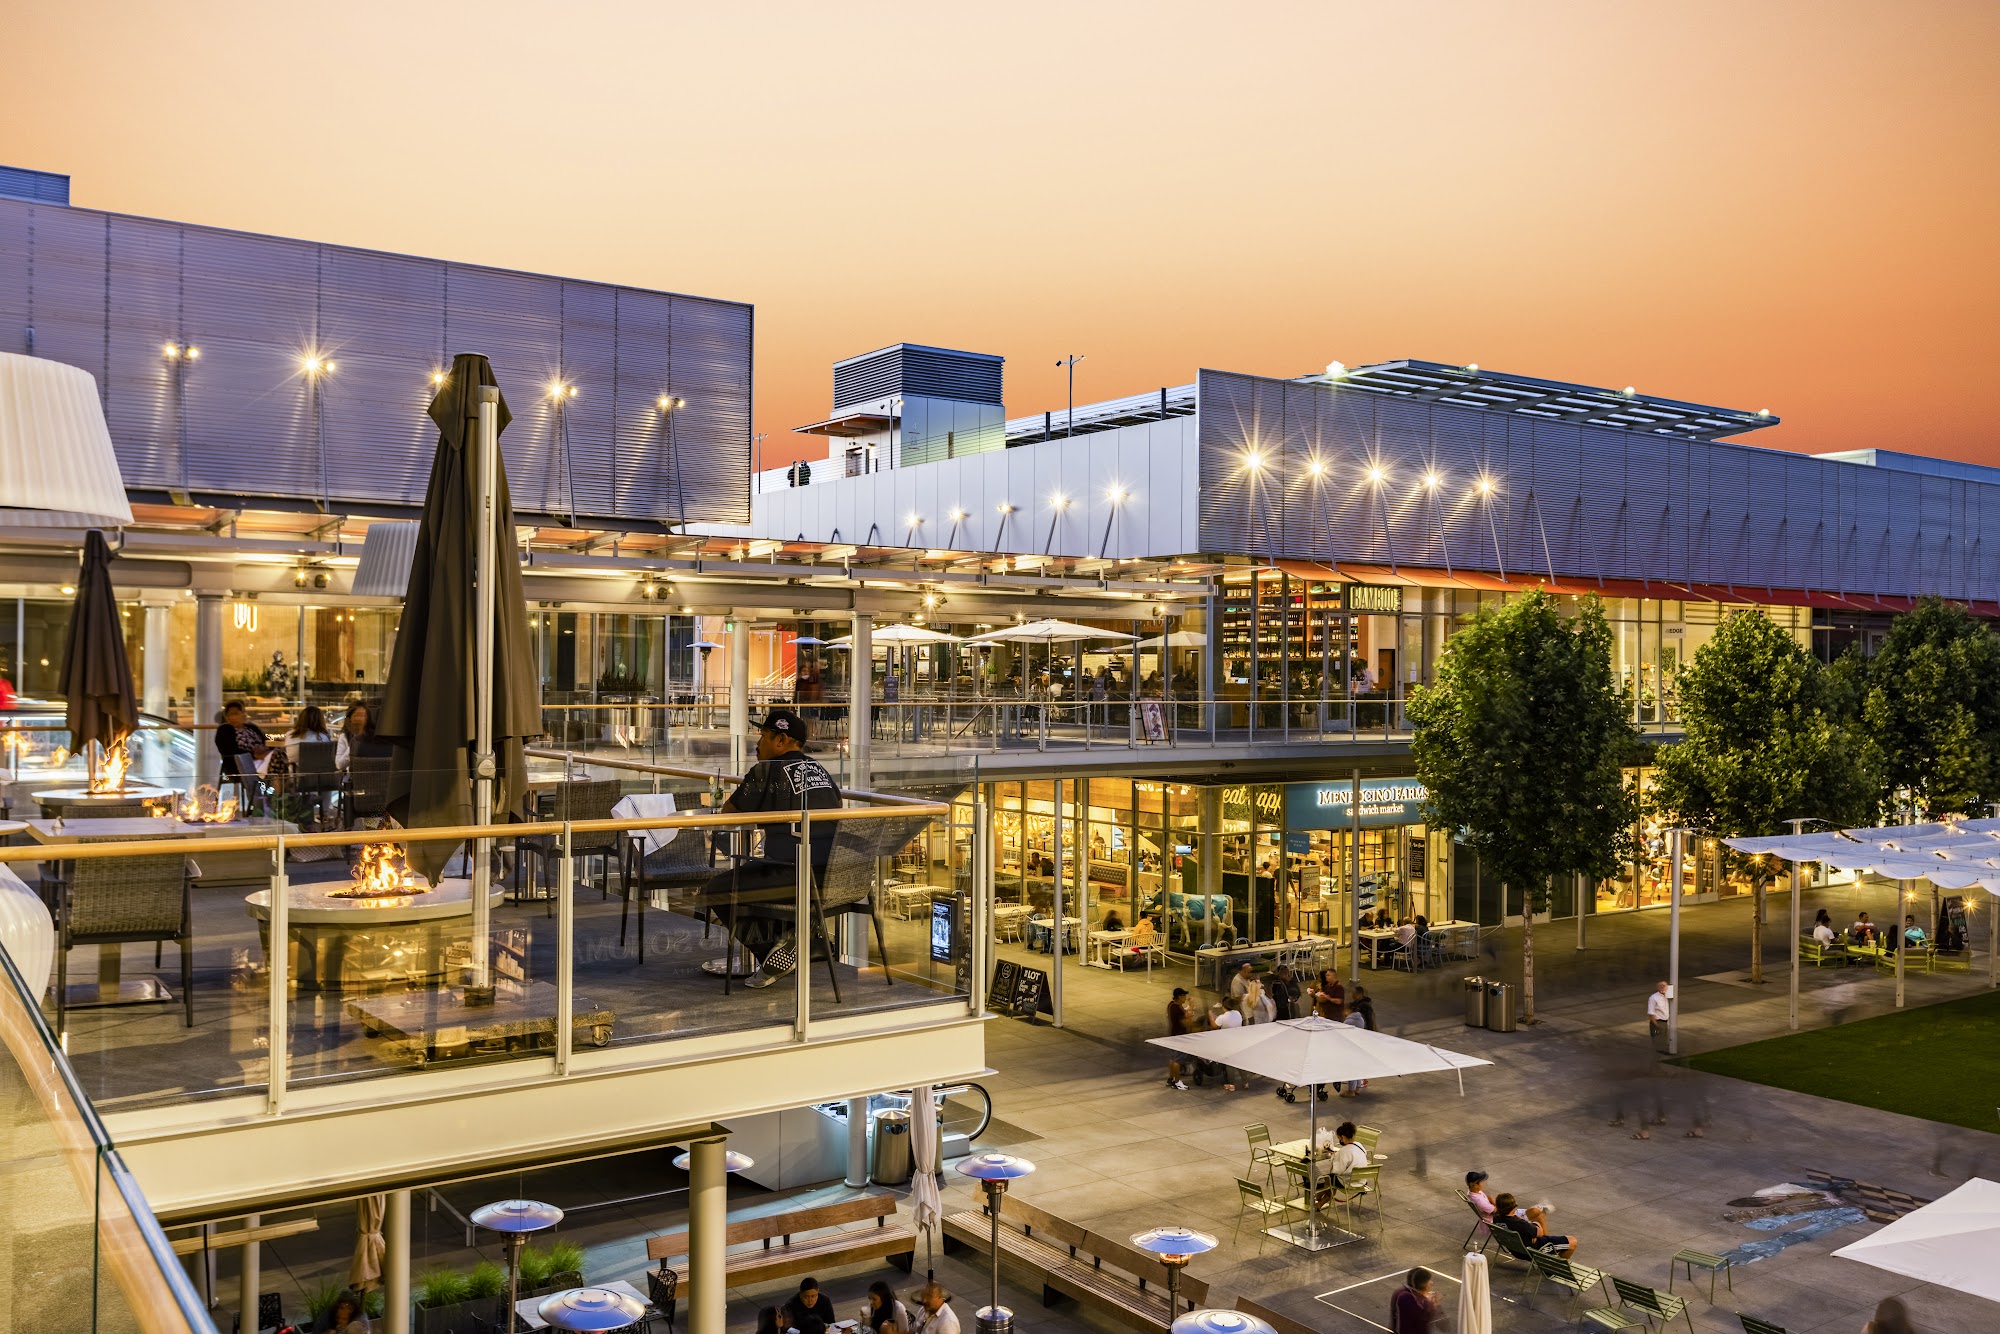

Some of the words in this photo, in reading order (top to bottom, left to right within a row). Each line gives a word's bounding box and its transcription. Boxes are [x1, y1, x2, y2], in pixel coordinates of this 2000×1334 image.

[1222, 785, 1247, 804] eat
[1346, 805, 1379, 816] sadwich
[1379, 803, 1404, 814] market
[1360, 874, 1373, 882] KIDS
[1361, 886, 1371, 894] EAT
[1360, 898, 1373, 906] FREE
[1027, 971, 1041, 980] LOT
